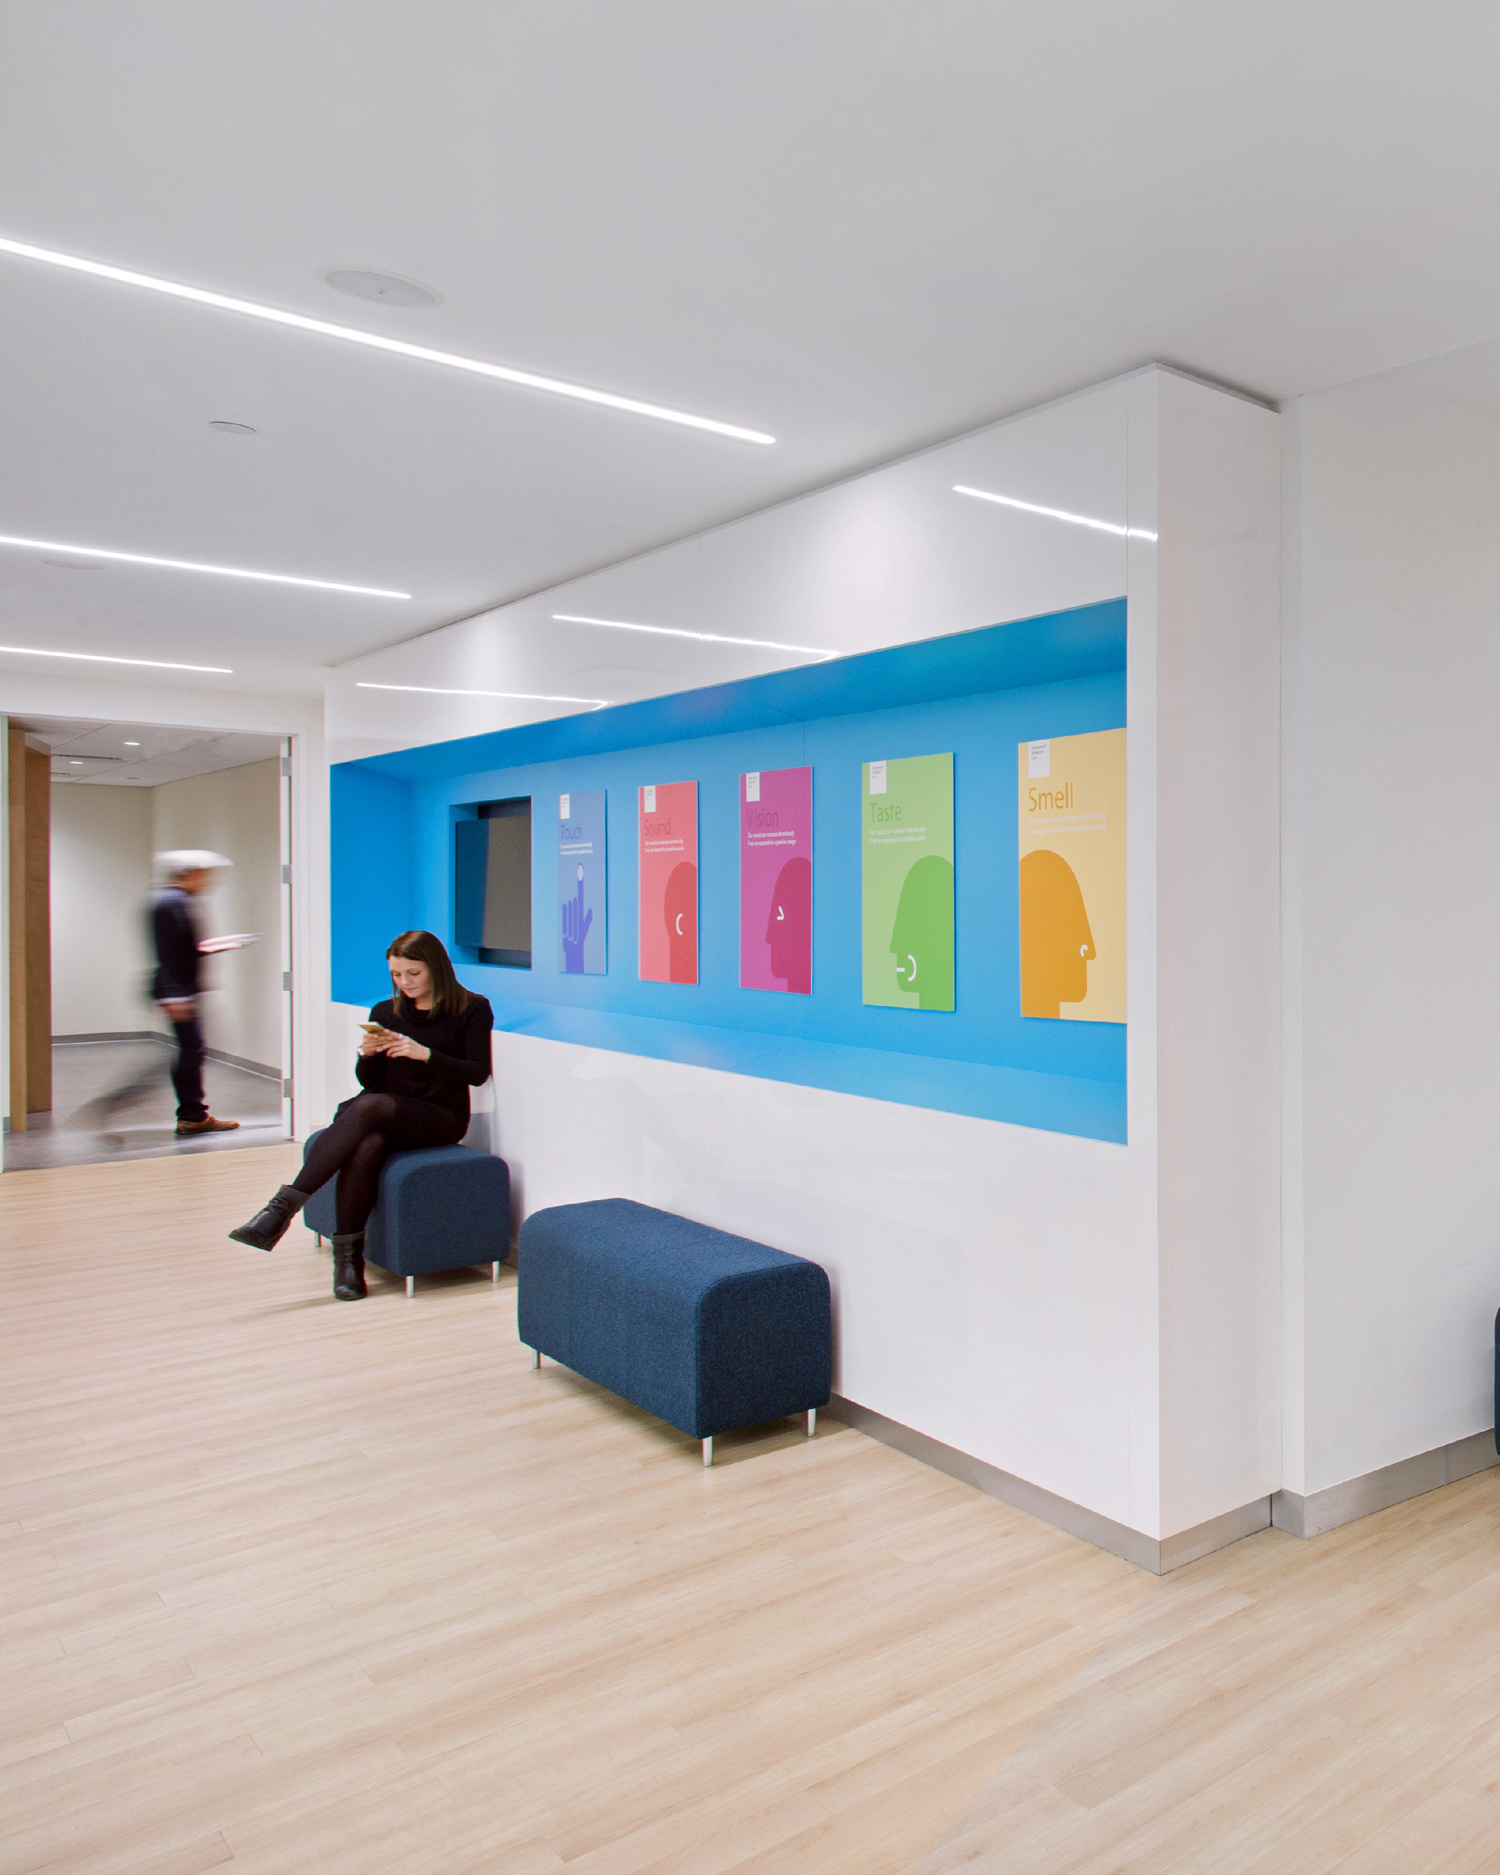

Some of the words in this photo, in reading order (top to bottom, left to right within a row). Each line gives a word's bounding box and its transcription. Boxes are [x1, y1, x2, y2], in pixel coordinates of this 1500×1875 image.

[1028, 782, 1073, 811] Smell
[746, 807, 779, 828] Vision
[869, 802, 902, 823] Taste
[560, 822, 583, 840] Touch
[644, 816, 671, 837] Sound
